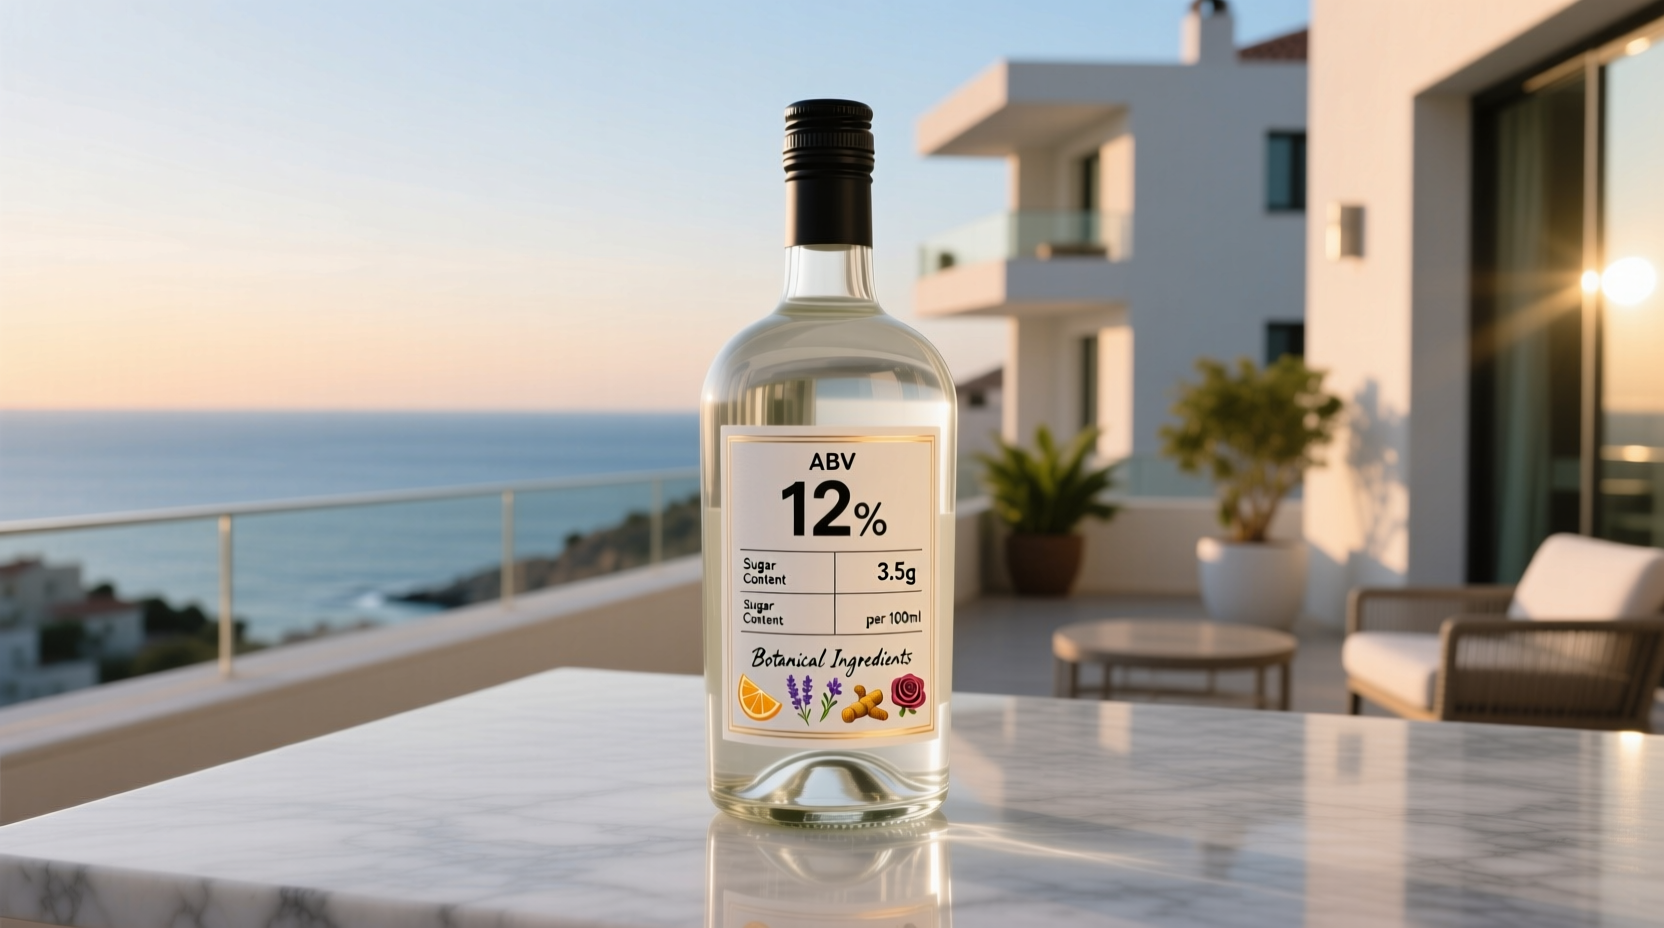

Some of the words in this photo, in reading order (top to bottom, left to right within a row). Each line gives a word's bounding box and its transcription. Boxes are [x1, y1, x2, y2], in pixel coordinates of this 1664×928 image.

[809, 452, 857, 471] ABV
[782, 479, 888, 537] 12%
[743, 557, 777, 574] Sugar
[877, 561, 916, 586] 3.5g
[743, 573, 787, 586] Content
[743, 612, 784, 626] Content
[866, 615, 887, 630] per
[889, 610, 921, 625] 100ml
[751, 647, 827, 668] Botanical
[830, 648, 913, 677] Ingredients
